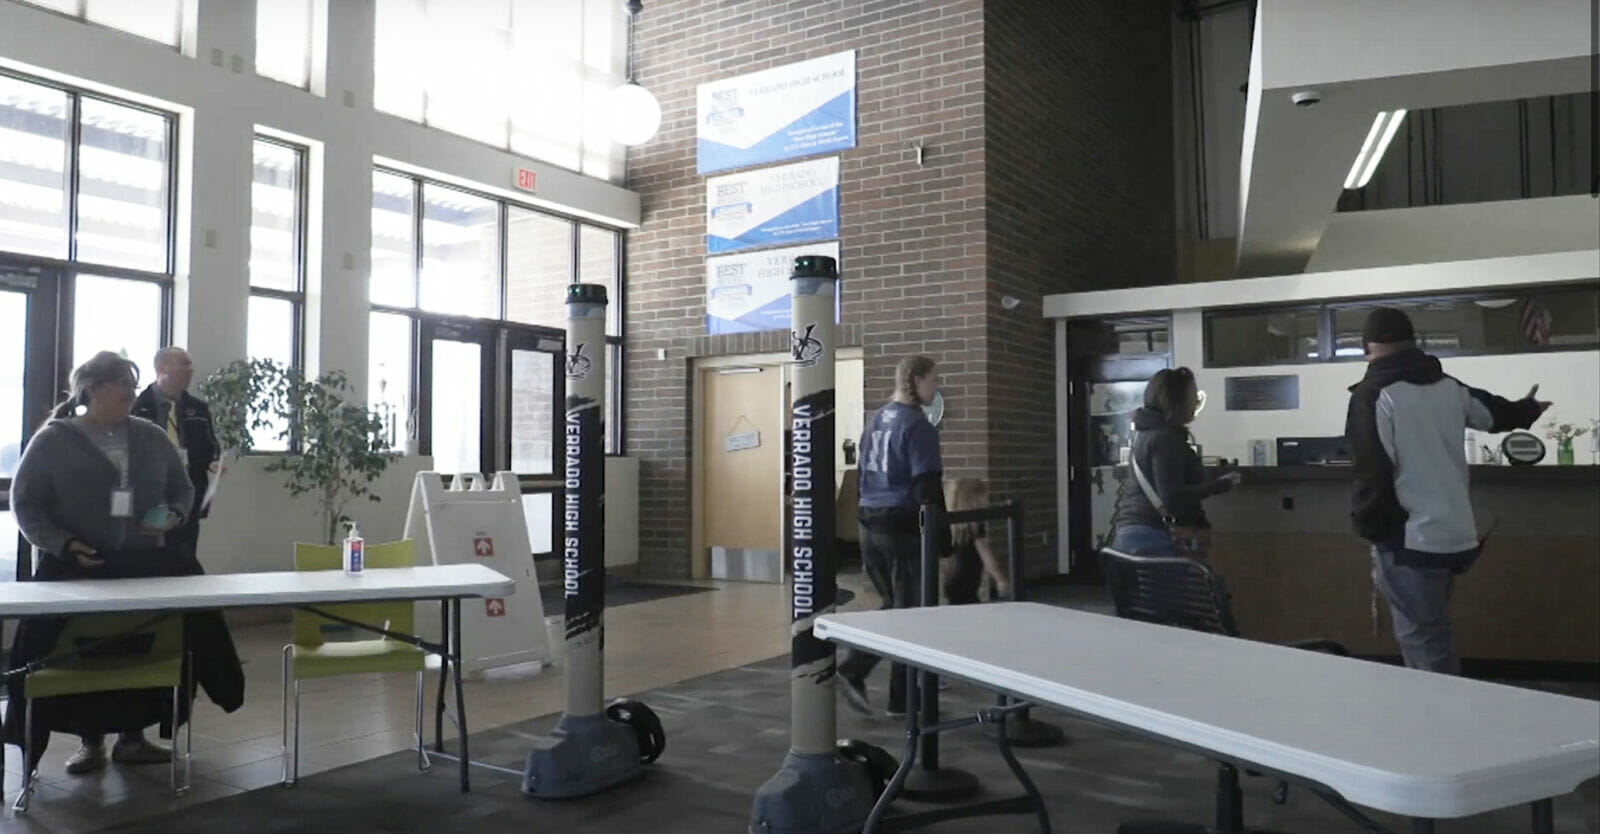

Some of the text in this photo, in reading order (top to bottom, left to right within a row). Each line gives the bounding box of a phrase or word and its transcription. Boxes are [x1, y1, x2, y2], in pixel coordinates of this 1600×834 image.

[519, 169, 536, 189] EXIT
[716, 182, 746, 197] BEST
[716, 263, 746, 278] BEST
[564, 413, 580, 599] VERRADO HIGH SCHOOL
[793, 405, 814, 618] VERRADO HIGH SCHOOL
